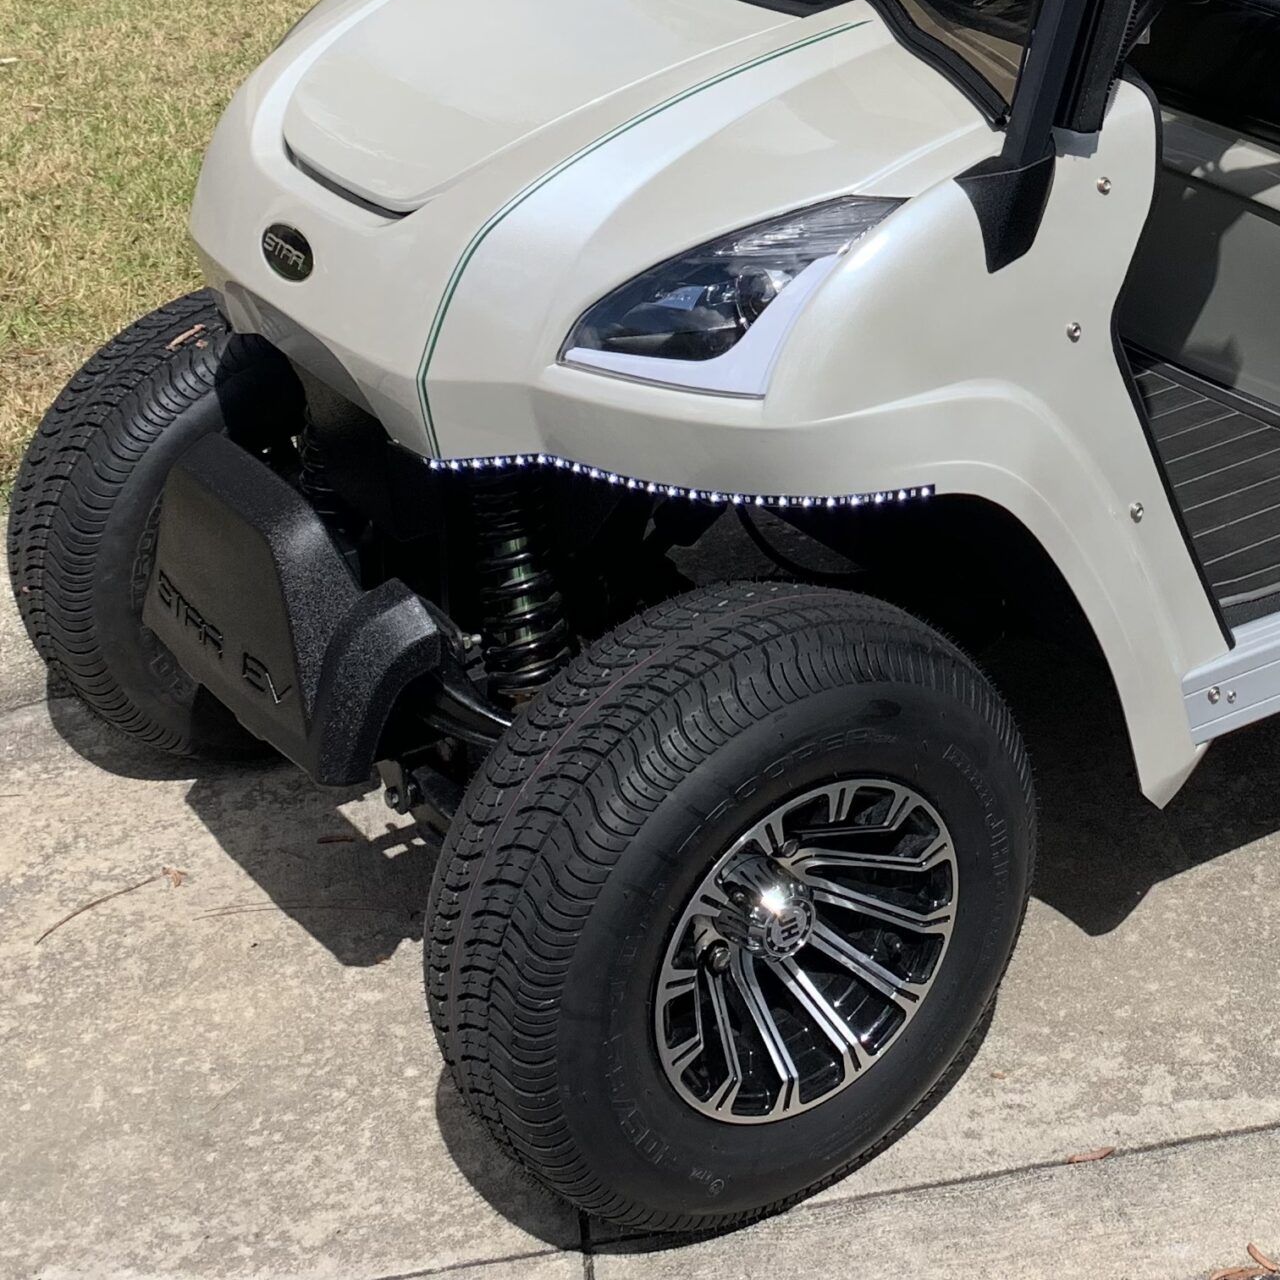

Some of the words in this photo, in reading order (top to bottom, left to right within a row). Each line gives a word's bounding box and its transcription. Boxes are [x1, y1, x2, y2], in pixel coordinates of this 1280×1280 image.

[263, 232, 305, 270] STAR
[157, 569, 223, 659] STAR
[243, 651, 292, 704] EV
